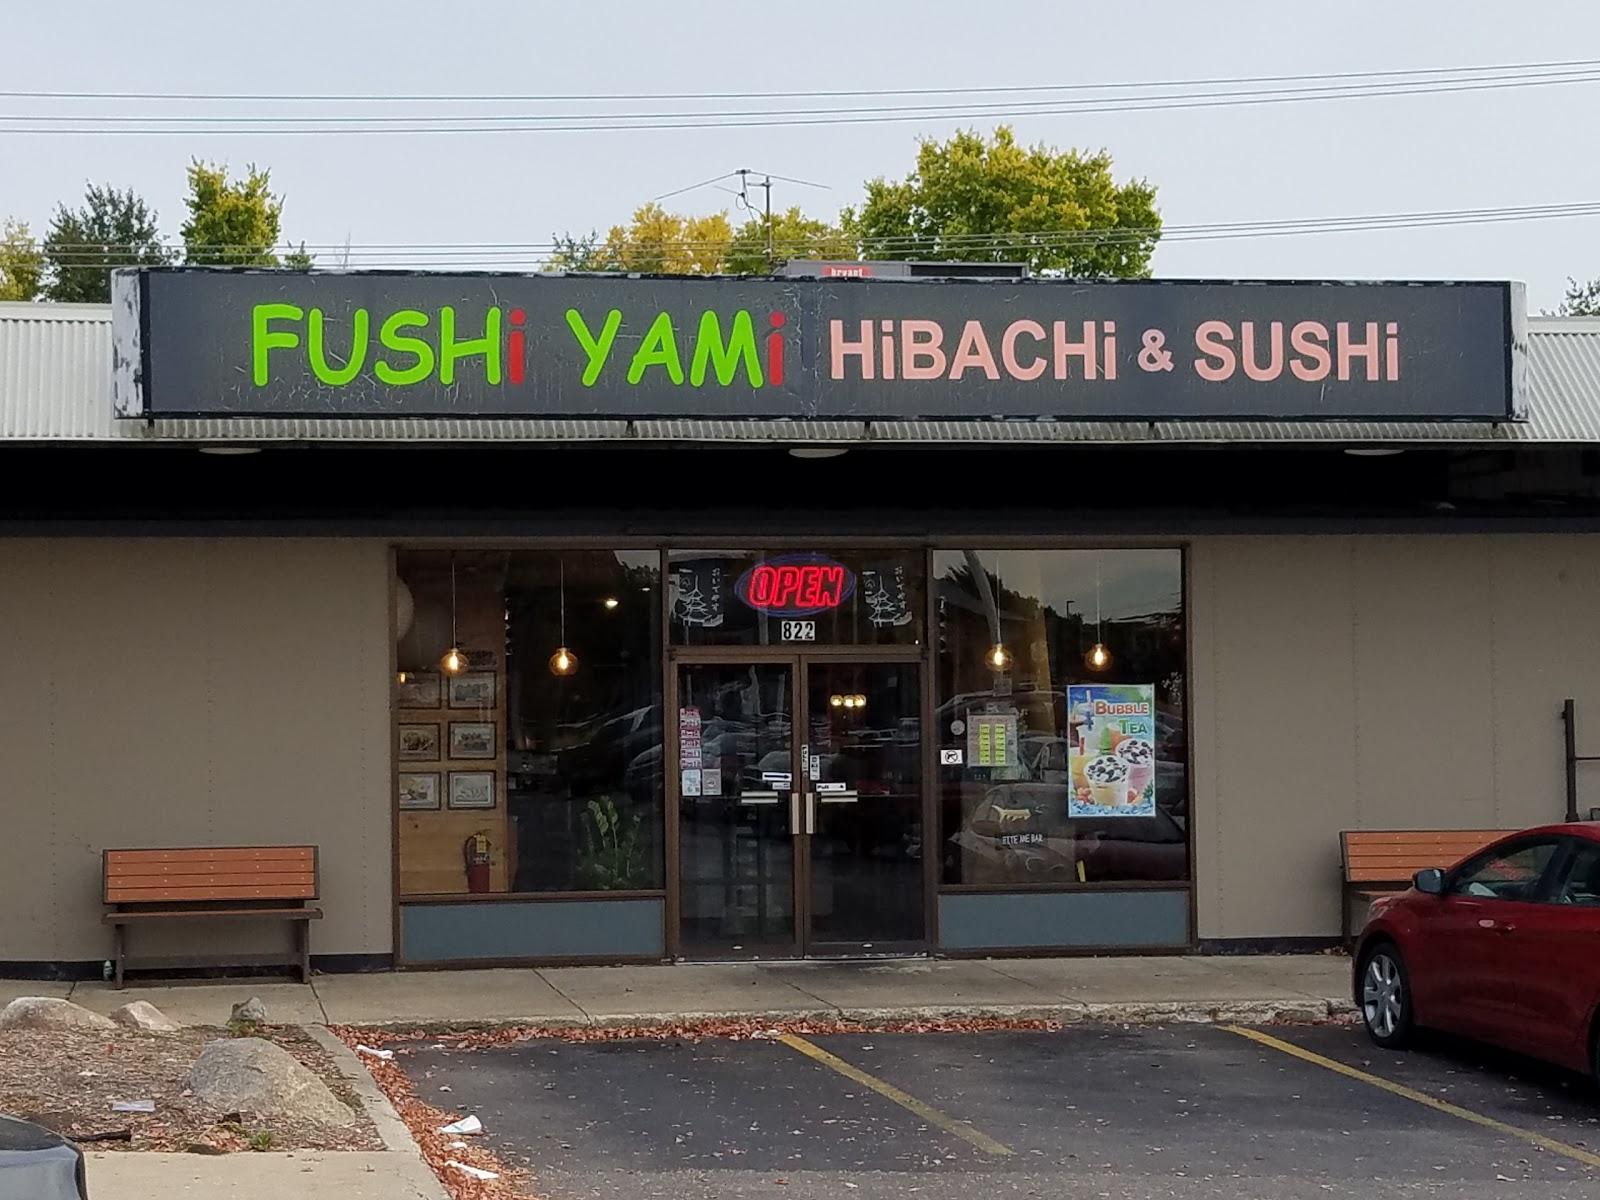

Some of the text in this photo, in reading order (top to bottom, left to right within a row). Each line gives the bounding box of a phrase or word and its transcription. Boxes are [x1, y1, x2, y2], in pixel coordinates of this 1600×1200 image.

[1137, 329, 1173, 372] &
[750, 567, 843, 607] OPEN
[783, 622, 814, 640] 822
[1094, 701, 1150, 715] BUBBLE
[1120, 720, 1148, 734] TEA
